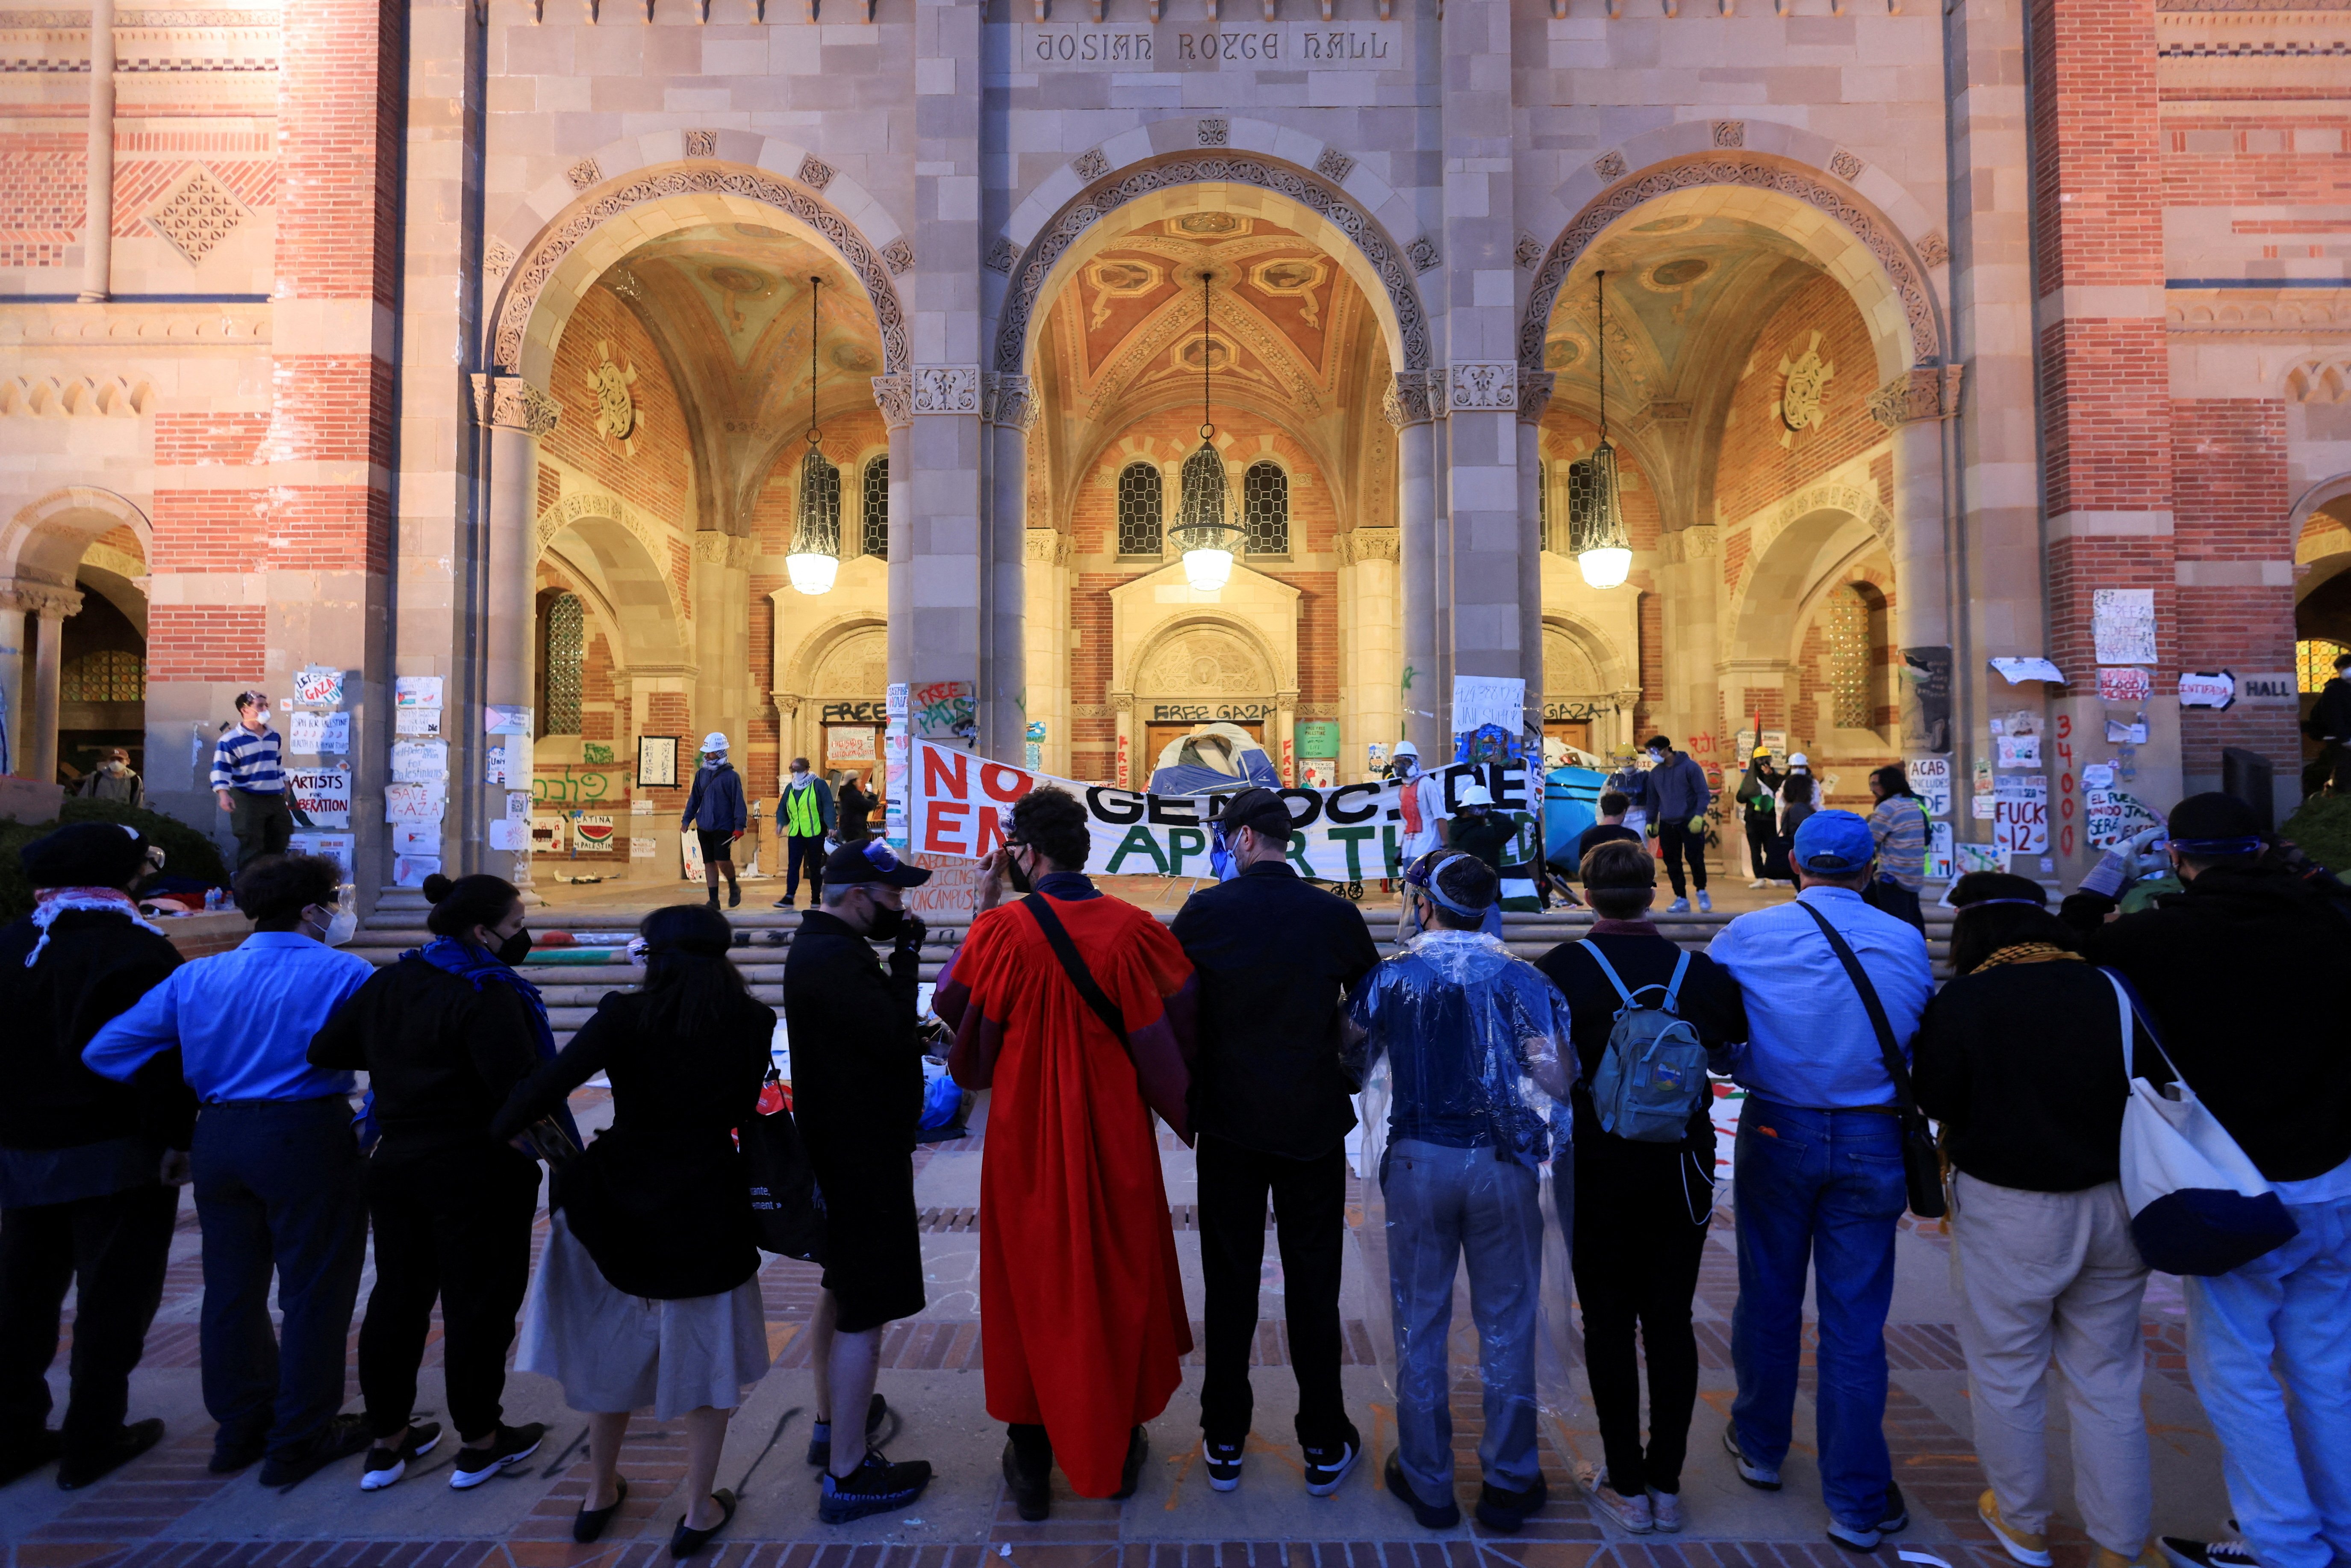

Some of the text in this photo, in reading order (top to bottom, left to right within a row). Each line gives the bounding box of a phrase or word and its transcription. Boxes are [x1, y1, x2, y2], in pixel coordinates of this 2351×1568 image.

[1036, 32, 1388, 60] JOSIAH ROYCE HALL
[297, 674, 312, 689] LET
[305, 678, 335, 700] GAZA
[2246, 681, 2291, 696] HALL
[918, 682, 966, 707] FREE
[2180, 684, 2228, 696] INTIFADA
[822, 702, 886, 722] FREE
[1154, 704, 1277, 720] FREE GAZA
[1544, 703, 1611, 720] GAZA
[309, 719, 319, 728] FOR
[291, 738, 308, 748] HEALTH
[1117, 735, 1128, 788] FREE
[1911, 760, 1946, 775] ACAB
[290, 774, 342, 789] ARTISTS
[393, 767, 443, 781] Palestinians
[922, 746, 1034, 802] NO
[1909, 778, 1949, 788] INCLUDES
[390, 788, 427, 800] SAVE
[2092, 793, 2106, 805] EL
[392, 802, 439, 816] GAZA
[1996, 802, 2046, 825] FUCK
[576, 816, 611, 824] LATINA
[2011, 825, 2030, 851] 12
[914, 853, 975, 869] ABOLISH
[915, 869, 973, 889] OLICING
